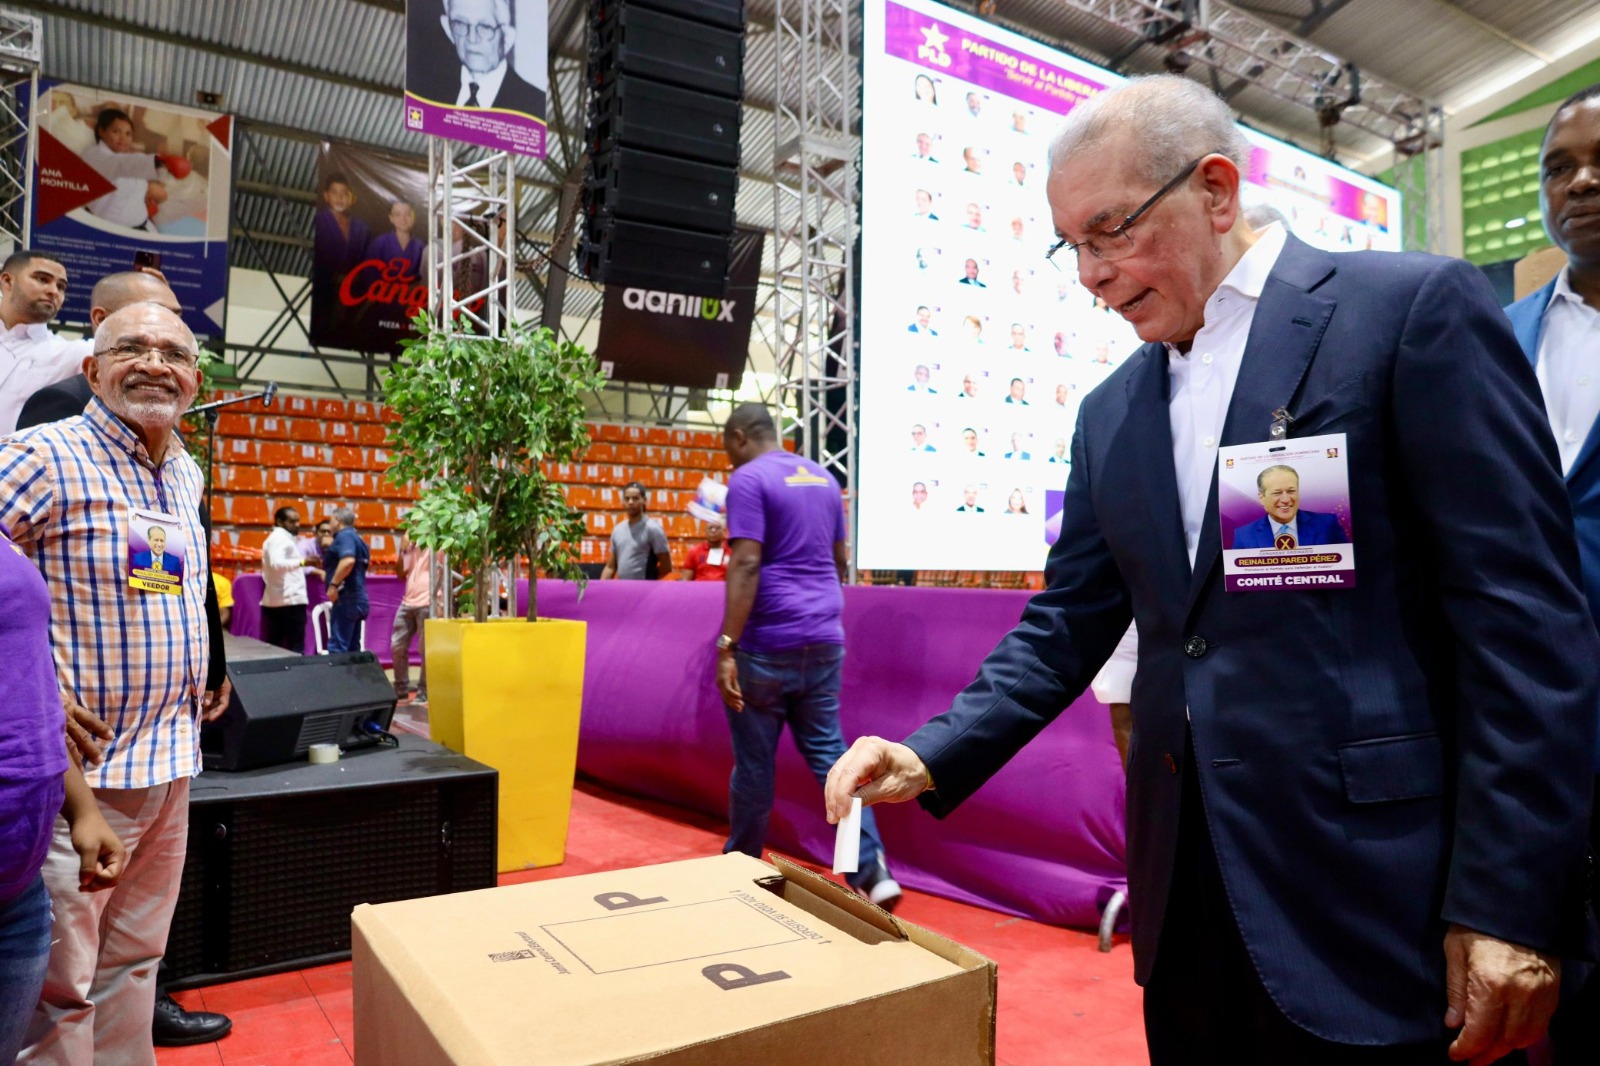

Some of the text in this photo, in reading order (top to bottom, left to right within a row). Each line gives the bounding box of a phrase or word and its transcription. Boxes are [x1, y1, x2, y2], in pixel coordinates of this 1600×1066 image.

[918, 45, 951, 67] PLD
[961, 38, 1099, 97] PARTIDO DE LA LIBERA
[41, 168, 62, 178] ANA
[40, 177, 89, 192] MONTILLA
[378, 320, 400, 329] PIZZA
[1238, 558, 1279, 566] REINALDO
[1310, 553, 1337, 562] PÉREZ
[142, 581, 170, 591] VEEDOR
[1236, 574, 1344, 587] COMITÉ CENTRAL
[593, 892, 669, 911] P
[755, 902, 777, 915] VOTO
[774, 913, 789, 921] SU
[783, 917, 823, 940] DEPOSITE
[514, 931, 572, 975] Junta Central Electoral
[701, 963, 792, 991] P
